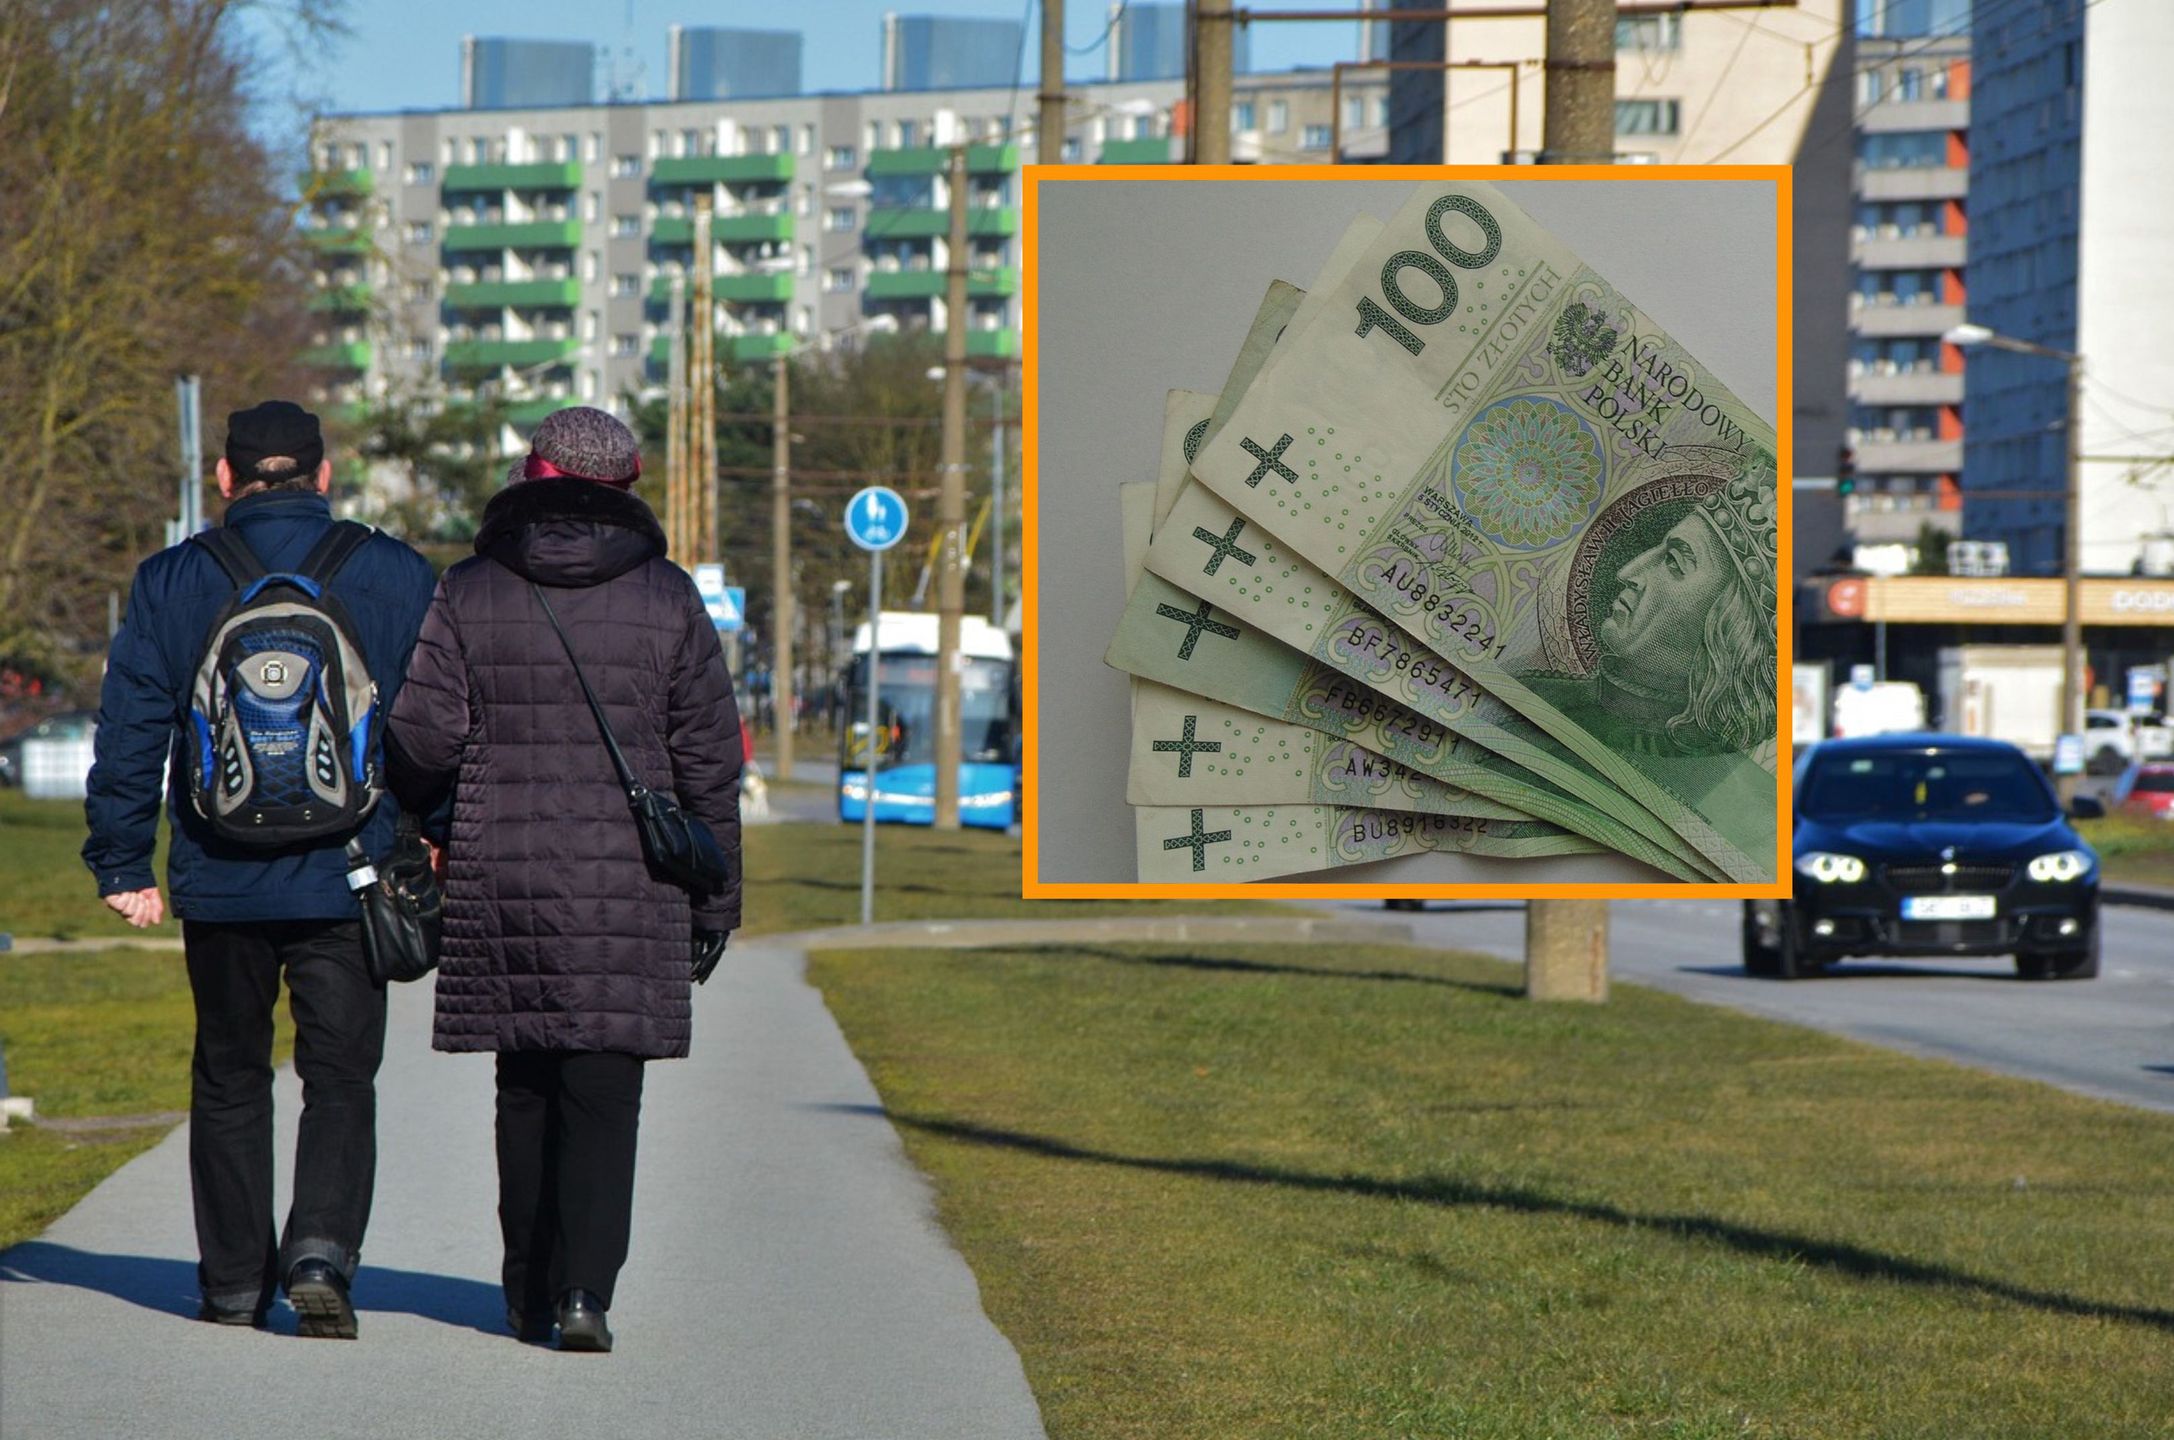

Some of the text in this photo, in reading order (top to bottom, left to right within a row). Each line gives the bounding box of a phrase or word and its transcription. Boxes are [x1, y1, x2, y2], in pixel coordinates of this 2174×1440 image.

[1355, 194, 1502, 357] 100
[1443, 266, 1562, 414] STO ZŁOTYCH
[1582, 385, 1670, 461] POLSKI
[1601, 360, 1672, 425] BANK
[1622, 335, 1755, 454] NARODOWY
[1403, 512, 1429, 533] PREZES
[1417, 493, 1425, 501] 5
[1423, 498, 1461, 530] STYCZNIA
[1460, 526, 1480, 542] 2012
[1423, 486, 1473, 528] WARSZAWA
[1618, 482, 1709, 531] JAGIEŁŁO
[1380, 564, 1507, 660] AU8832241
[1347, 626, 1482, 709] BF7865471
[1324, 686, 1461, 755] FB6672911
[1353, 816, 1488, 843] BU8916322
